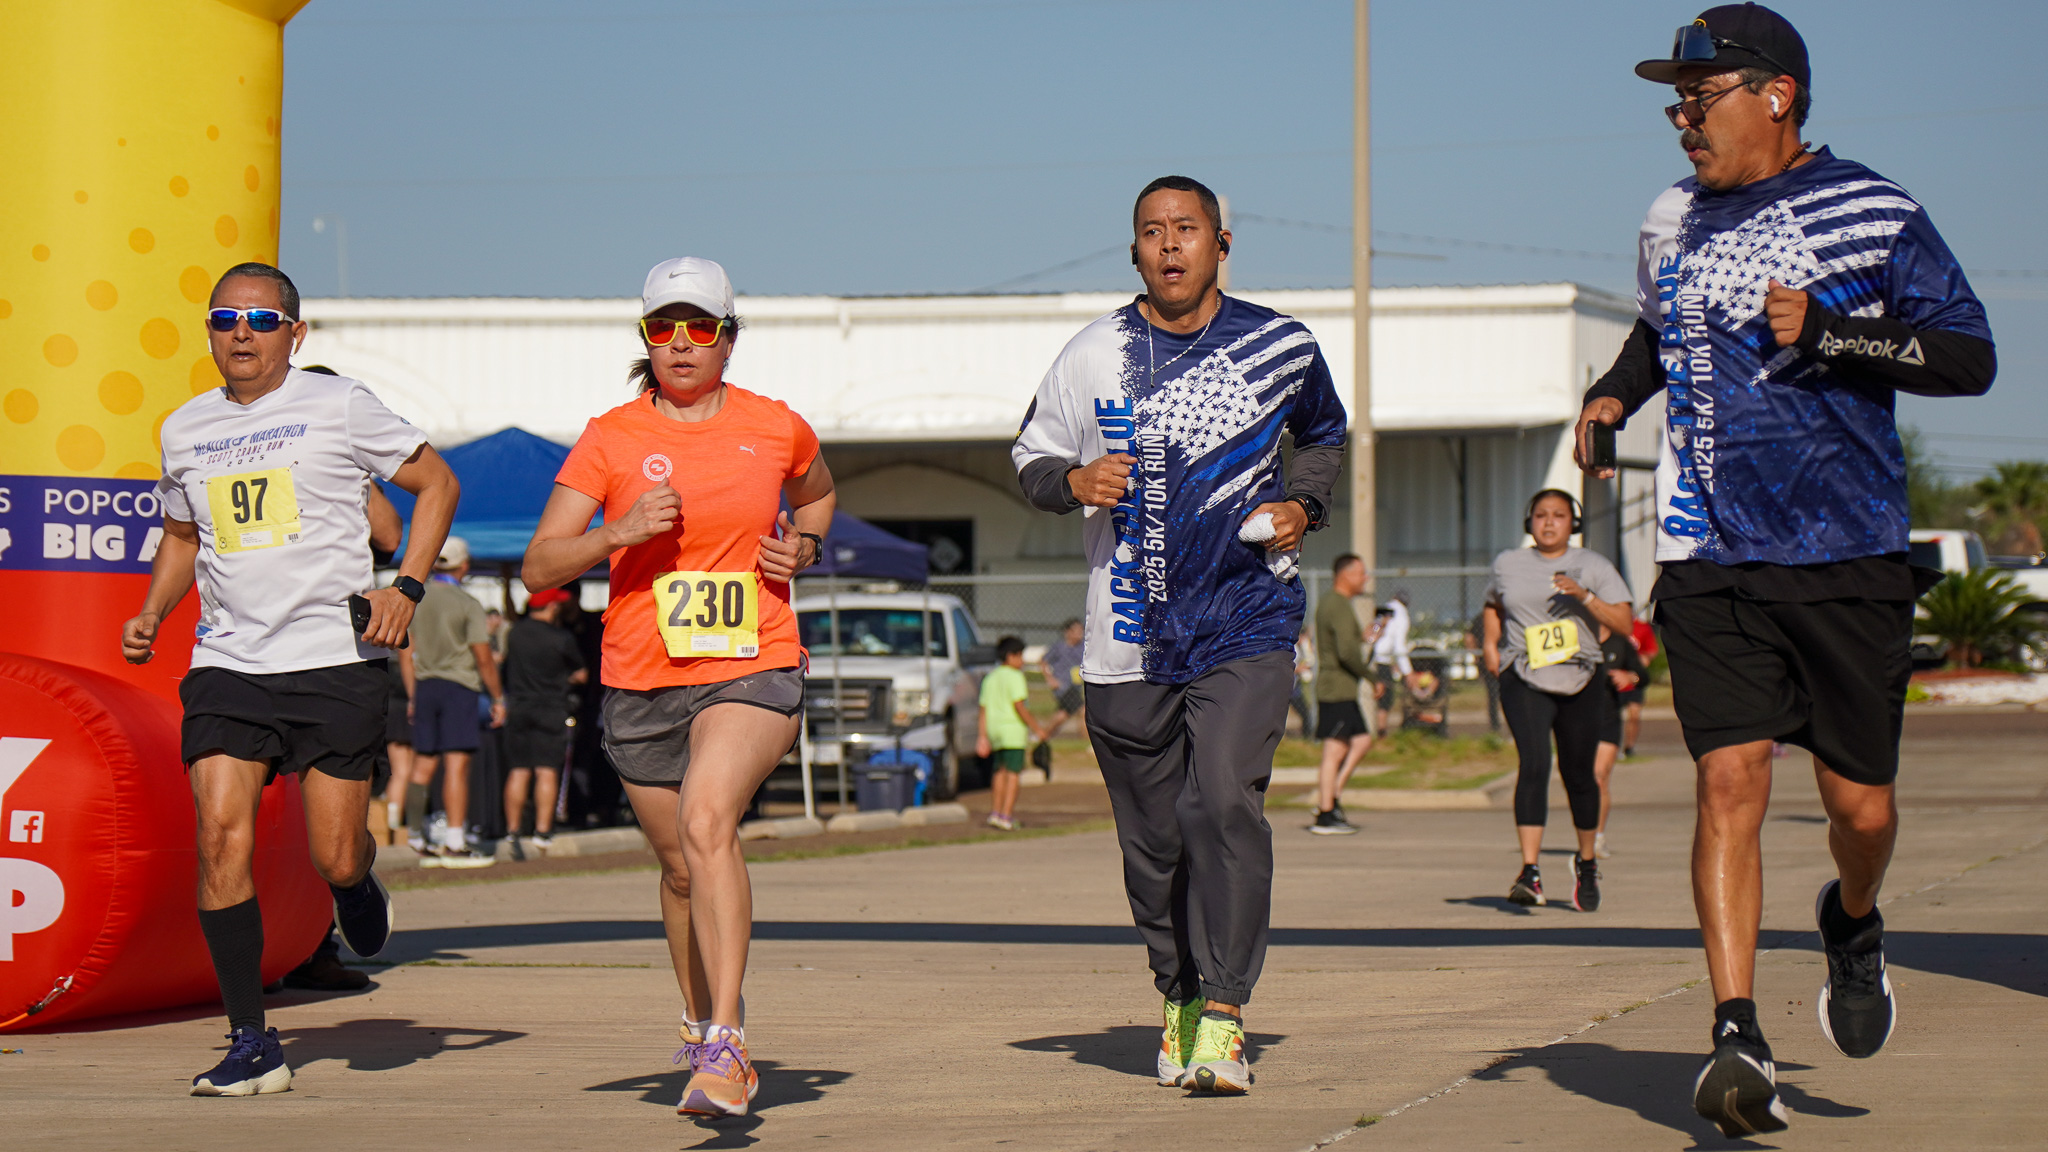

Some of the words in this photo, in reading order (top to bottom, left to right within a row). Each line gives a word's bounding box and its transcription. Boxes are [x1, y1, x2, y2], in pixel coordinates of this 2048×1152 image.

[1656, 251, 1683, 349] BLUE
[1681, 293, 1708, 339] RUN
[1818, 329, 1899, 359] Reebok
[206, 450, 233, 465] SCOTT
[235, 444, 262, 458] CRANE
[266, 440, 284, 452] RUN
[249, 424, 307, 444] MARATHON
[1094, 397, 1139, 479] LUE
[1140, 434, 1166, 473] RUN
[1692, 436, 1715, 495] 2025
[231, 477, 268, 524] 97
[43, 522, 125, 561] BIG
[1110, 552, 1146, 644] BACK
[1146, 556, 1168, 603] 2025
[668, 580, 744, 628] 230
[1540, 625, 1565, 650] 29
